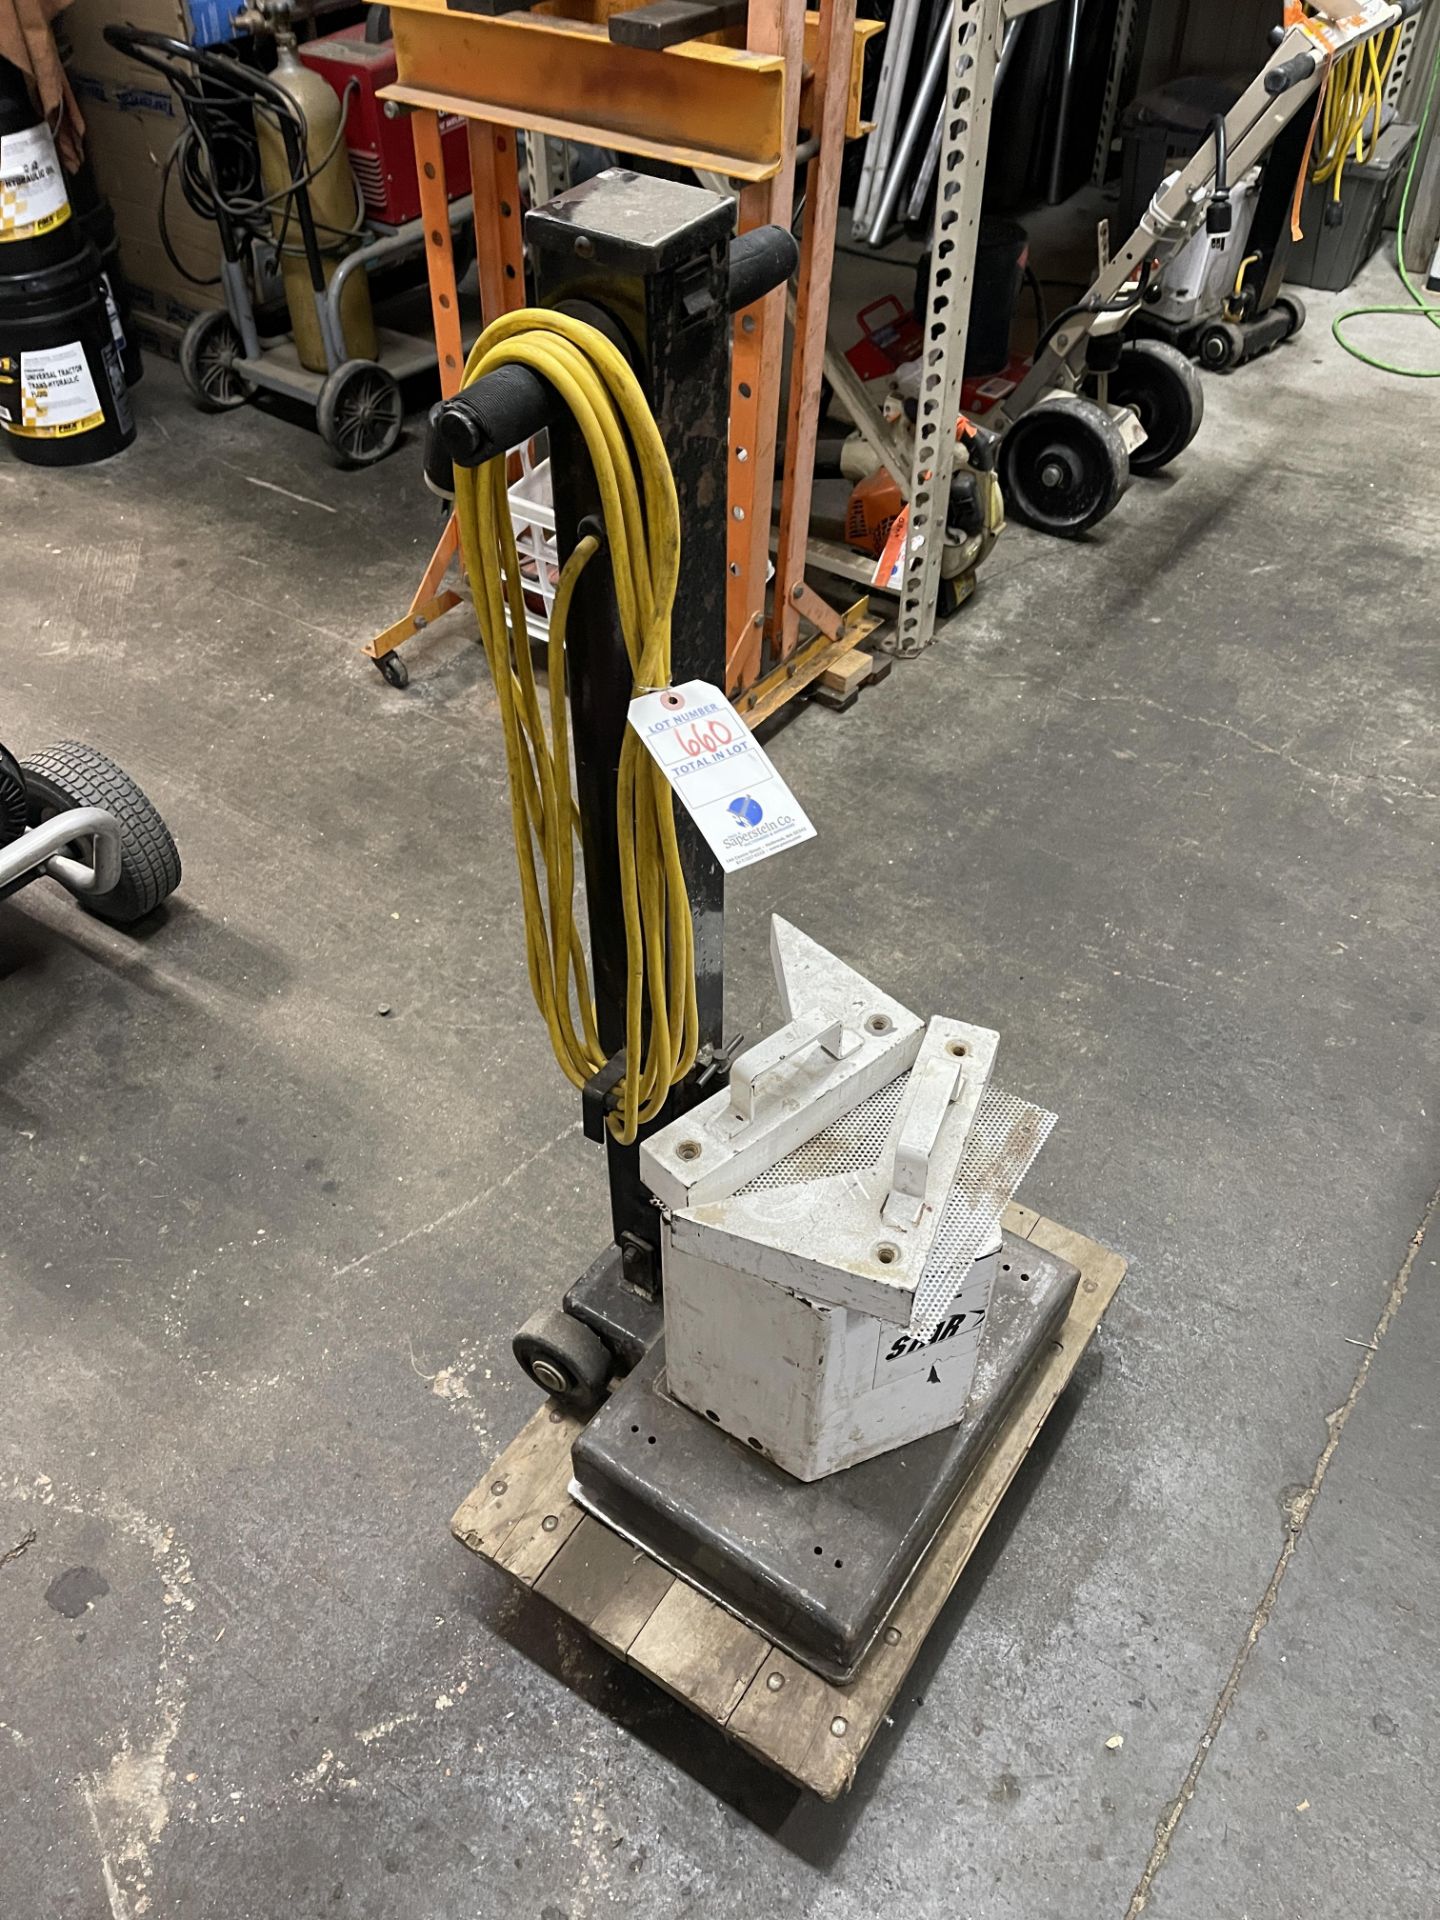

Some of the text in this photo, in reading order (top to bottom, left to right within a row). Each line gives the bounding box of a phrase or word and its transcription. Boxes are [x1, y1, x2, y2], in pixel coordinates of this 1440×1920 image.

[5, 169, 45, 187] HYDRAULIC
[26, 371, 57, 381] UNIVERSAL
[58, 364, 82, 376] TRACTOR
[31, 389, 48, 398] FLUID
[648, 703, 719, 734] LOT NUMBER
[674, 720, 732, 756] 660
[672, 741, 748, 776] TOTAL IN LOT
[723, 822, 778, 849] Saperstein
[777, 815, 795, 826] Co.
